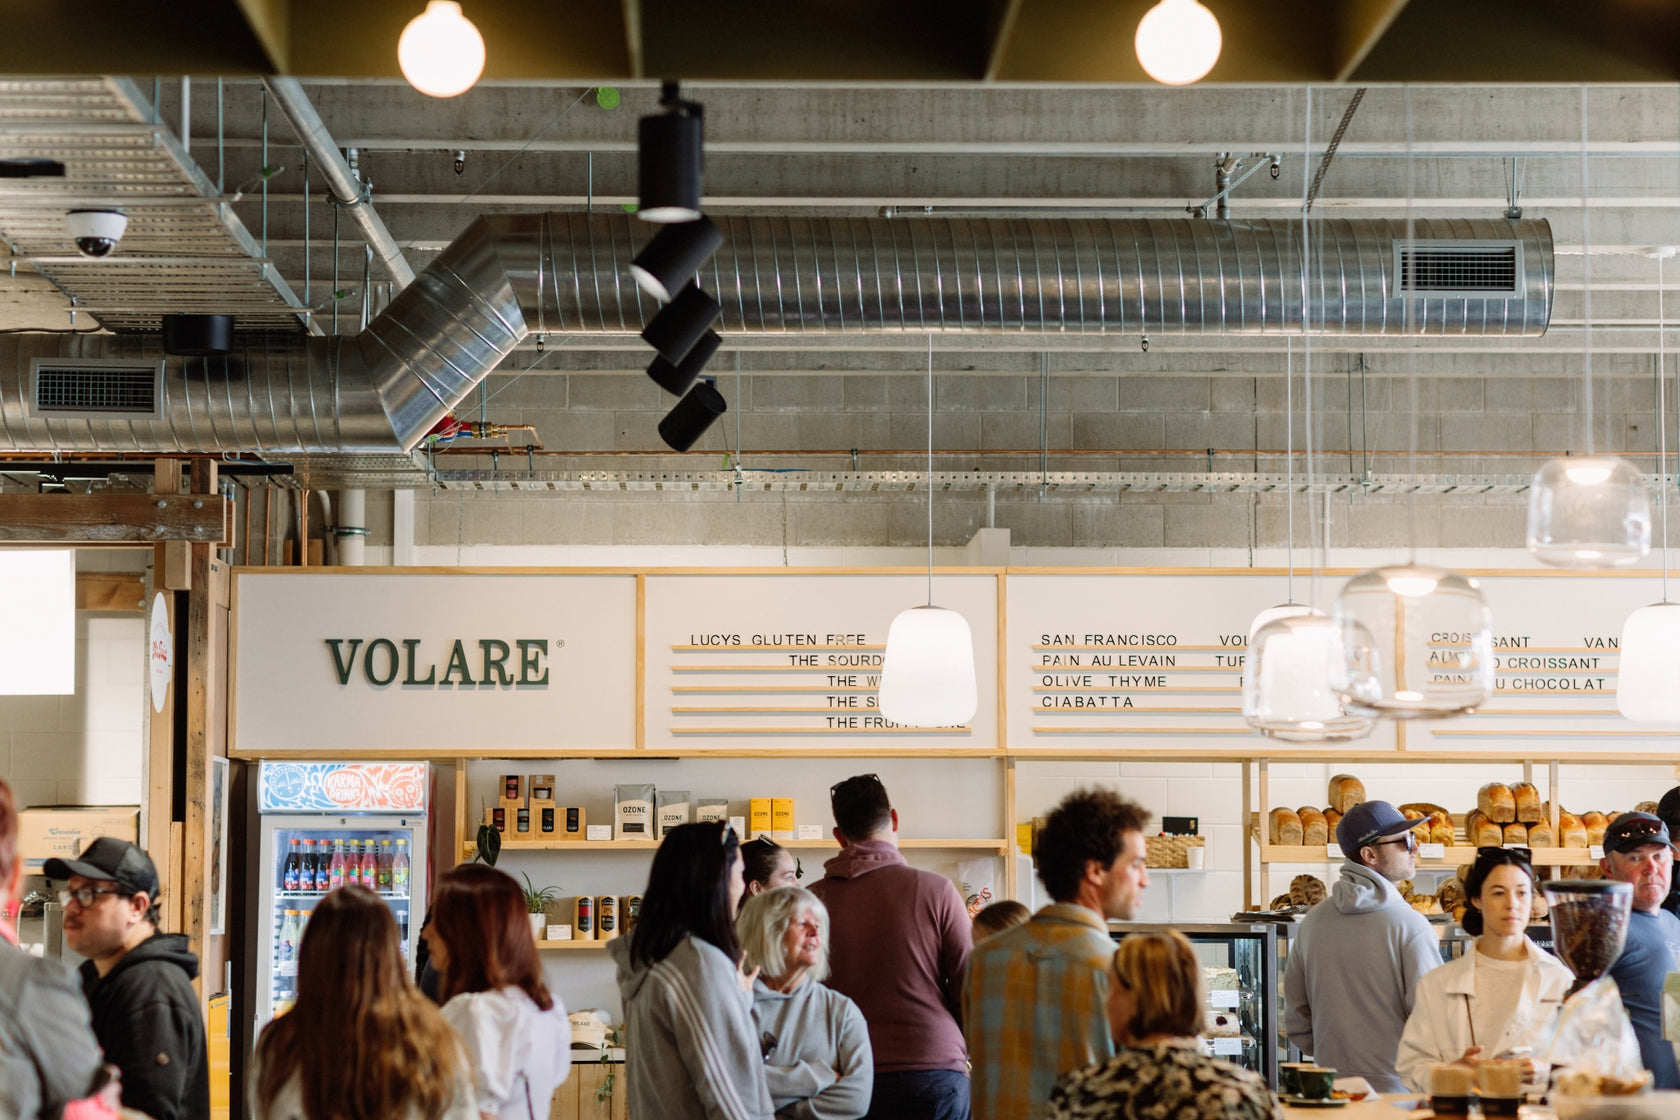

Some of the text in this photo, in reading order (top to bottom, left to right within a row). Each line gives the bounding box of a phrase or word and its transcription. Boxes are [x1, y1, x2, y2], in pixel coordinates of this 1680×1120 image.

[691, 634, 741, 646] LUCYS
[752, 634, 817, 646] GLUTEN
[1041, 634, 1177, 646] SAN FRANCISCO
[325, 638, 549, 686] VOLARE
[789, 655, 885, 667] THE SOURD
[1042, 655, 1176, 667] PAIN AU LEVAIN
[1508, 658, 1600, 669] CROISSANT
[827, 676, 857, 687] THE
[1042, 675, 1166, 687] OLIVE THYME
[1512, 678, 1605, 690] CHOCOLAT
[826, 696, 858, 708] THE
[1042, 696, 1133, 708] CIABATTA
[826, 717, 858, 729] THE
